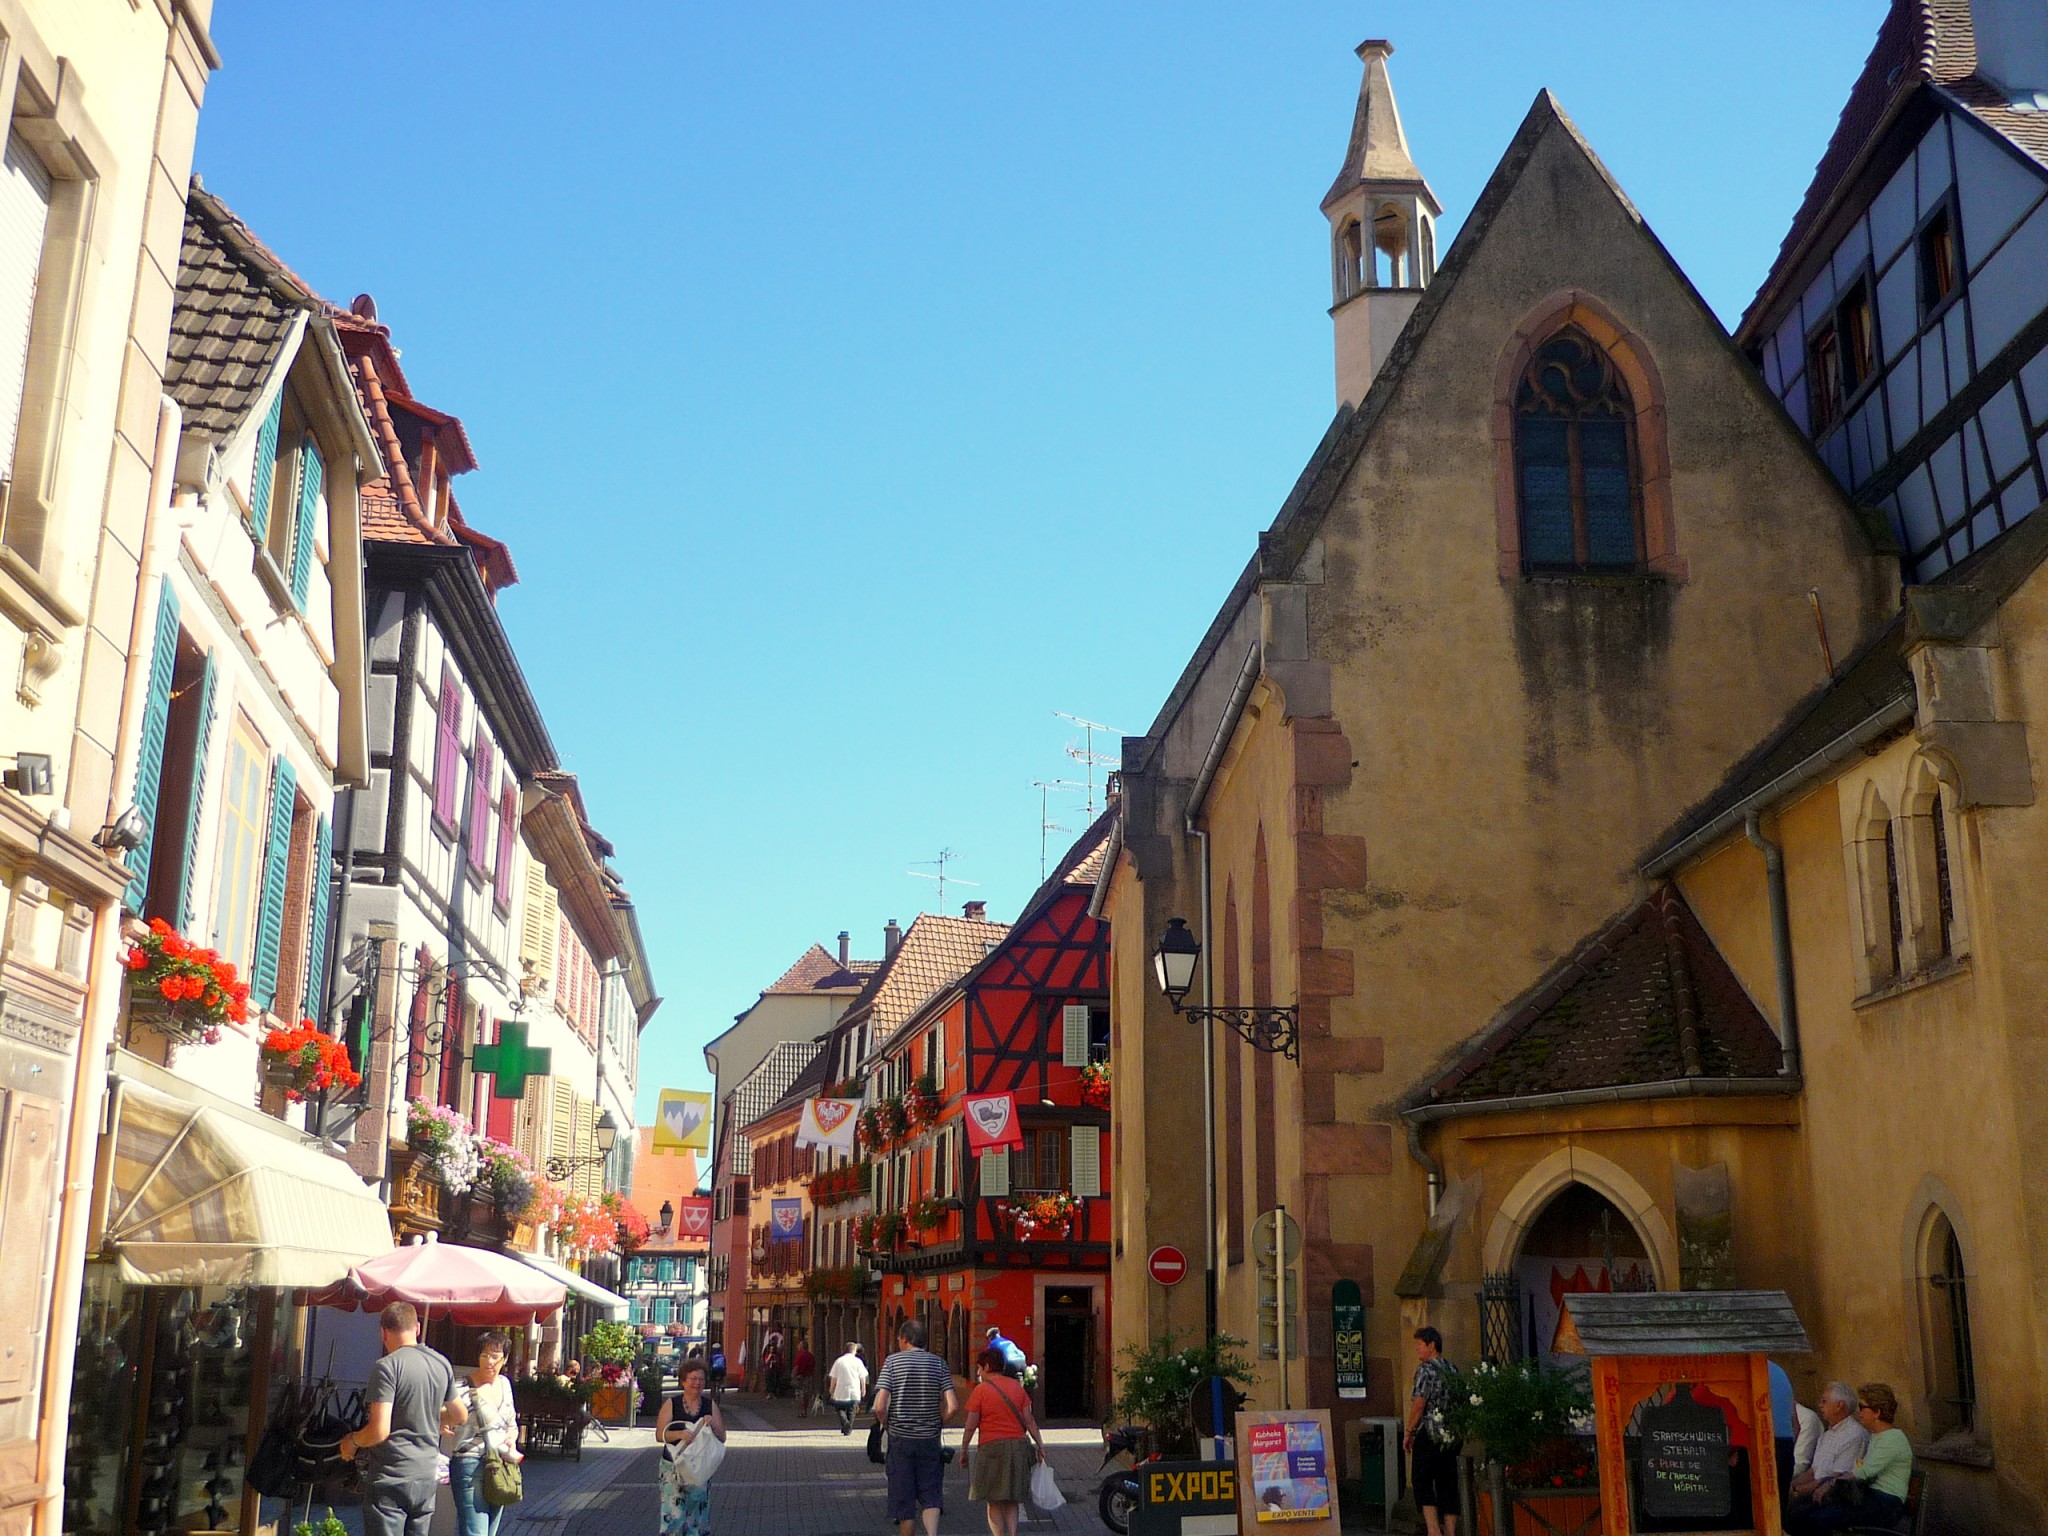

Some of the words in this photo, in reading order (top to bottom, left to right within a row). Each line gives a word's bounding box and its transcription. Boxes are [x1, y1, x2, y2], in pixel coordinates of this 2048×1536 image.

[1660, 1458, 1685, 1469] PLACE
[1688, 1461, 1702, 1470] DE
[1656, 1470, 1667, 1479] DE
[1150, 1470, 1234, 1502] EXPOS
[1272, 1511, 1293, 1519] EXPO
[1293, 1509, 1316, 1518] VENTE
